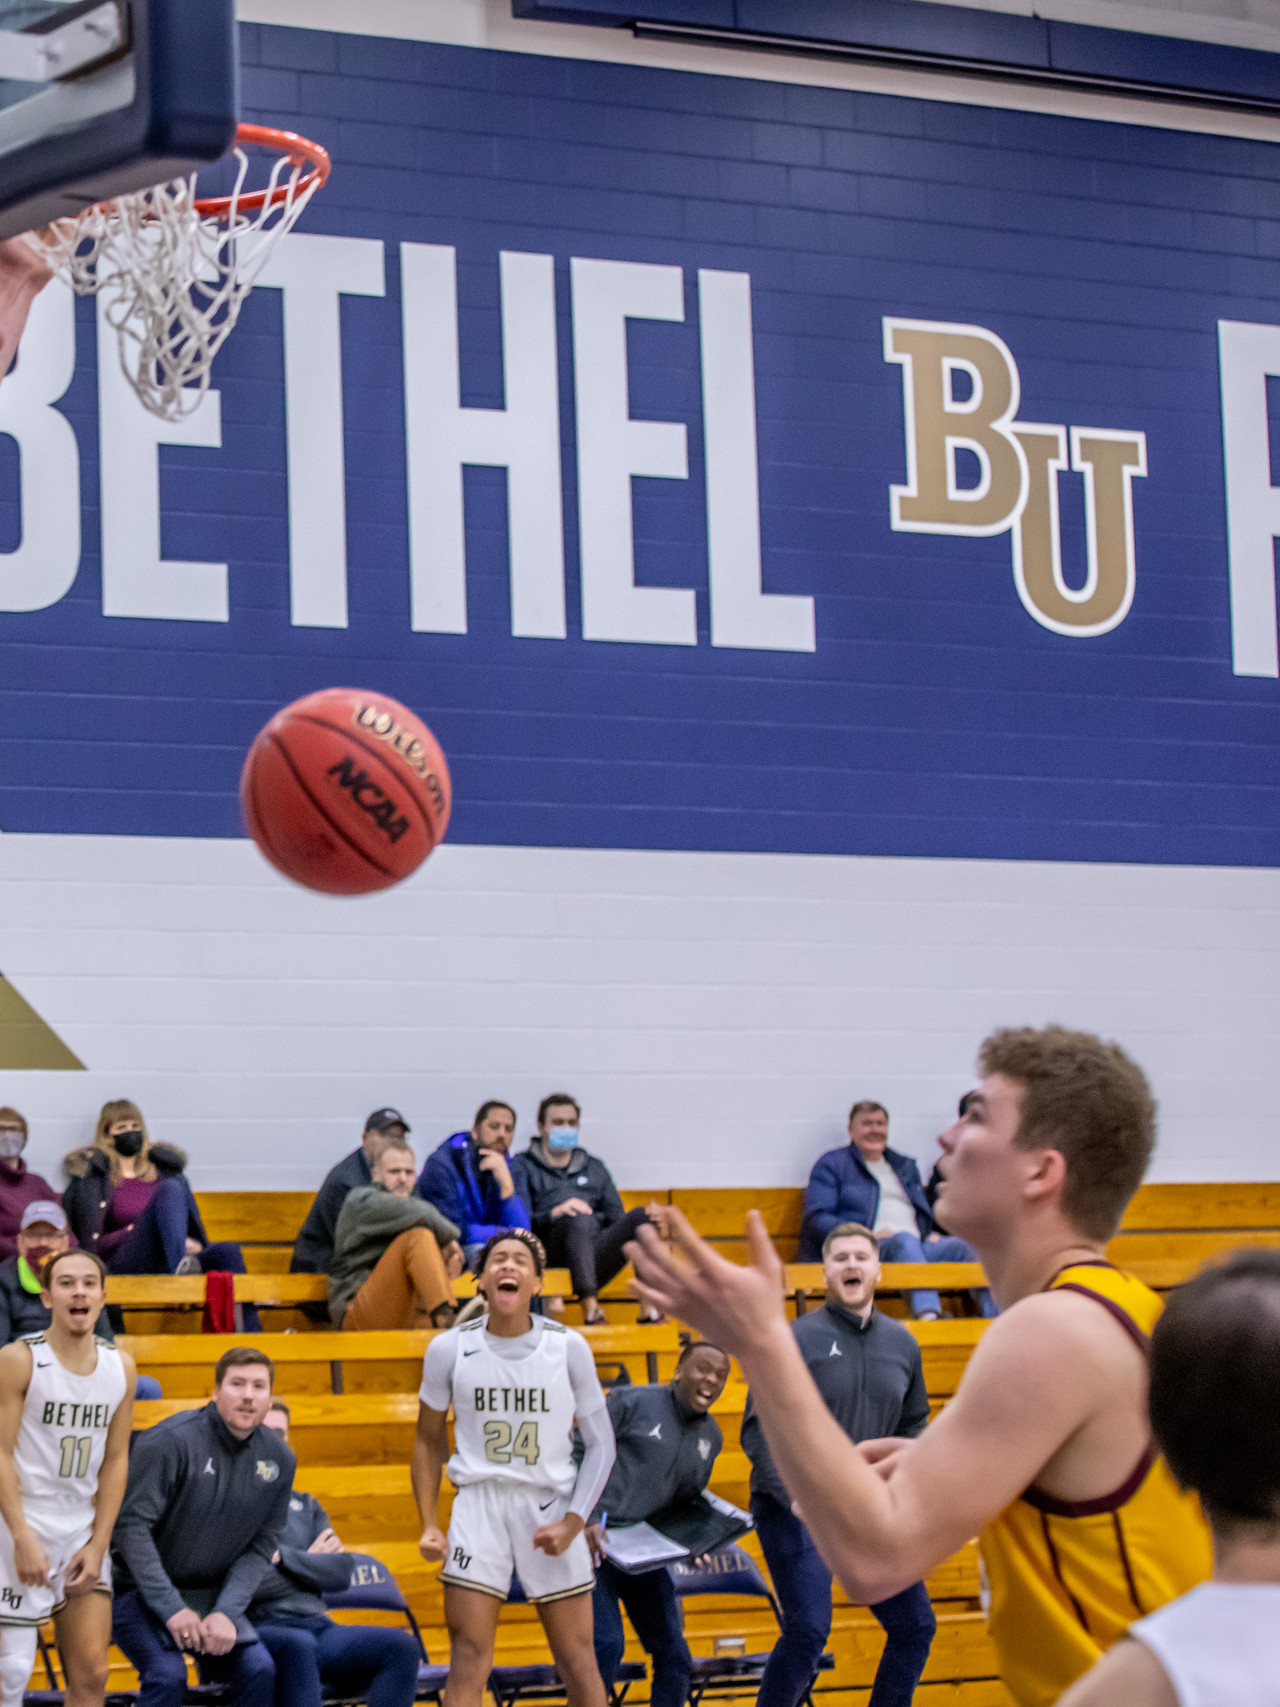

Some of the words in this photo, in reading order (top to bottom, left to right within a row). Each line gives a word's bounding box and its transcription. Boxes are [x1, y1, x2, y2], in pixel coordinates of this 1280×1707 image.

[882, 316, 1148, 637] BU
[328, 756, 410, 844] NCAA
[42, 1401, 109, 1428] BETHEL
[474, 1387, 550, 1412] BETHEL
[59, 1435, 92, 1478] 11
[483, 1420, 540, 1466] 24
[453, 1546, 472, 1570] BU
[1, 1587, 22, 1610] BU
